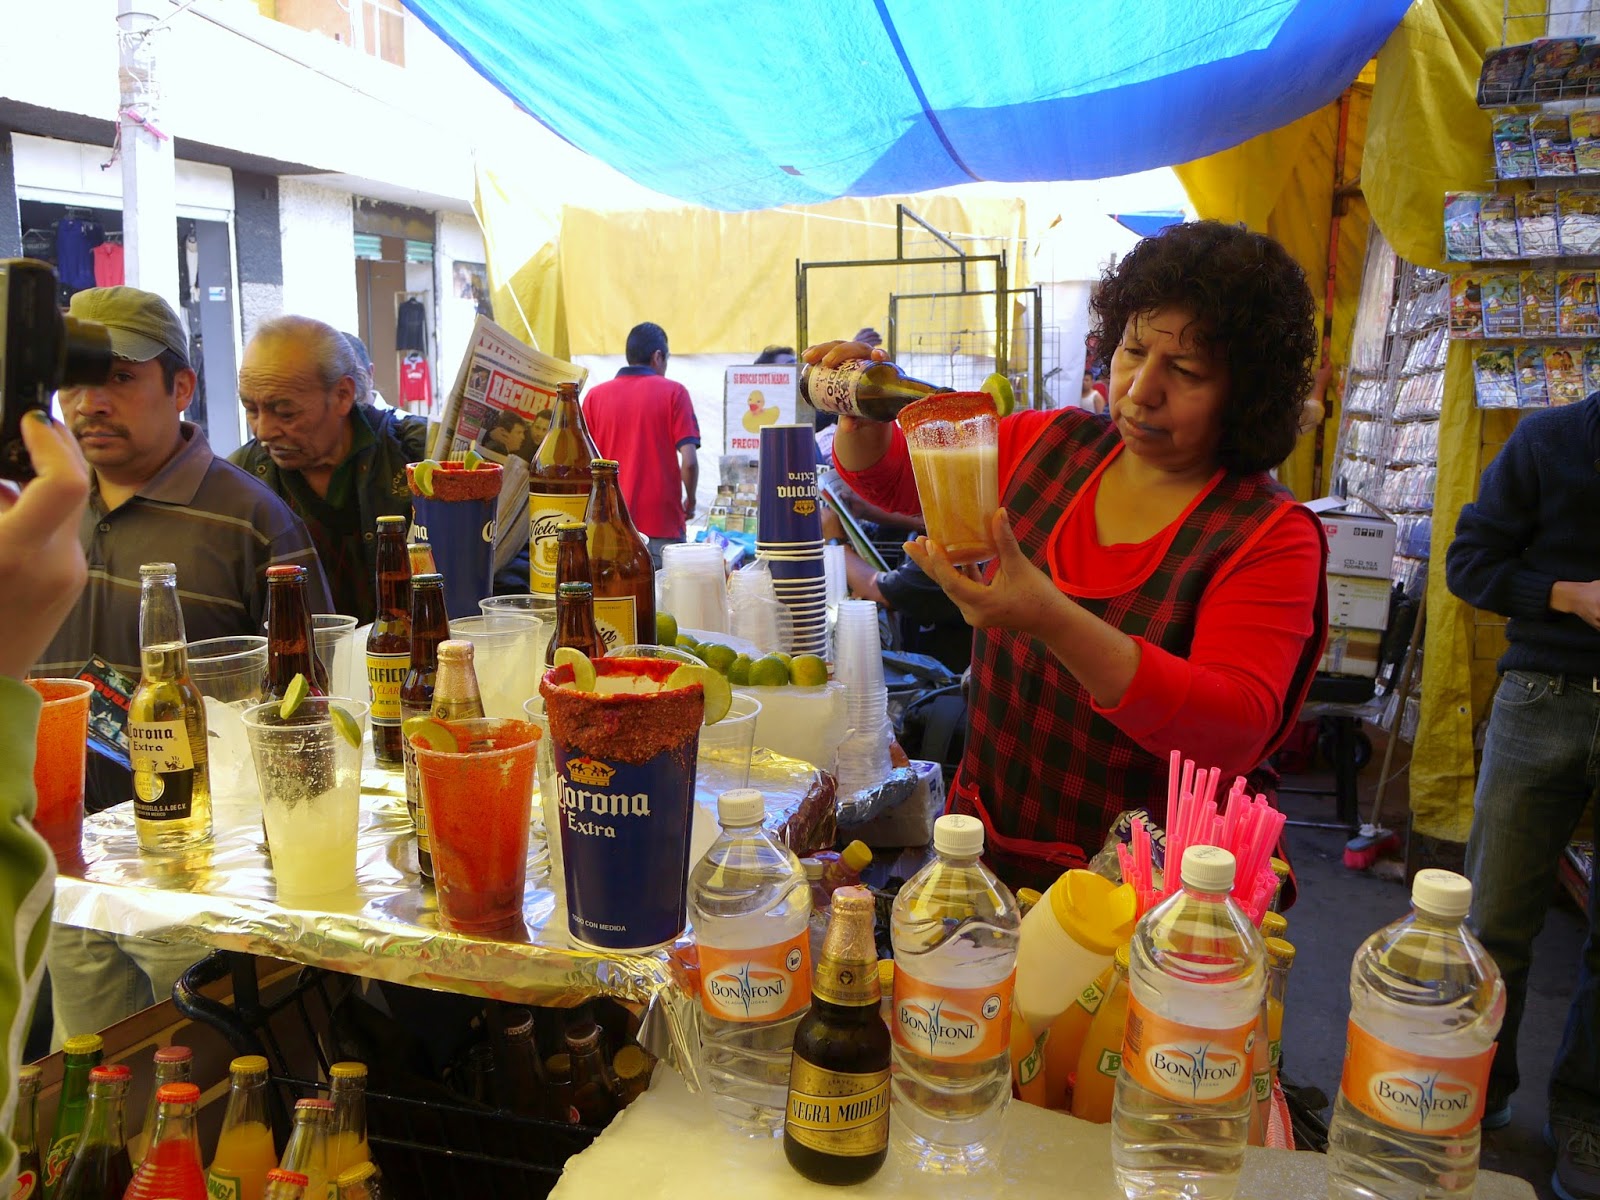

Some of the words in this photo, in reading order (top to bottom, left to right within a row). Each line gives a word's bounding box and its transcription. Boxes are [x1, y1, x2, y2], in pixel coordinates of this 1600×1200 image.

[1526, 294, 1537, 305] 2
[377, 685, 400, 695] CLAR
[133, 741, 164, 752] Extra
[556, 772, 651, 818] Corona
[567, 811, 617, 838] Extra
[585, 920, 599, 929] CON
[599, 923, 627, 932] MEDIDA
[792, 1098, 831, 1123] NEGRA
[836, 1088, 888, 1123] MODELO
